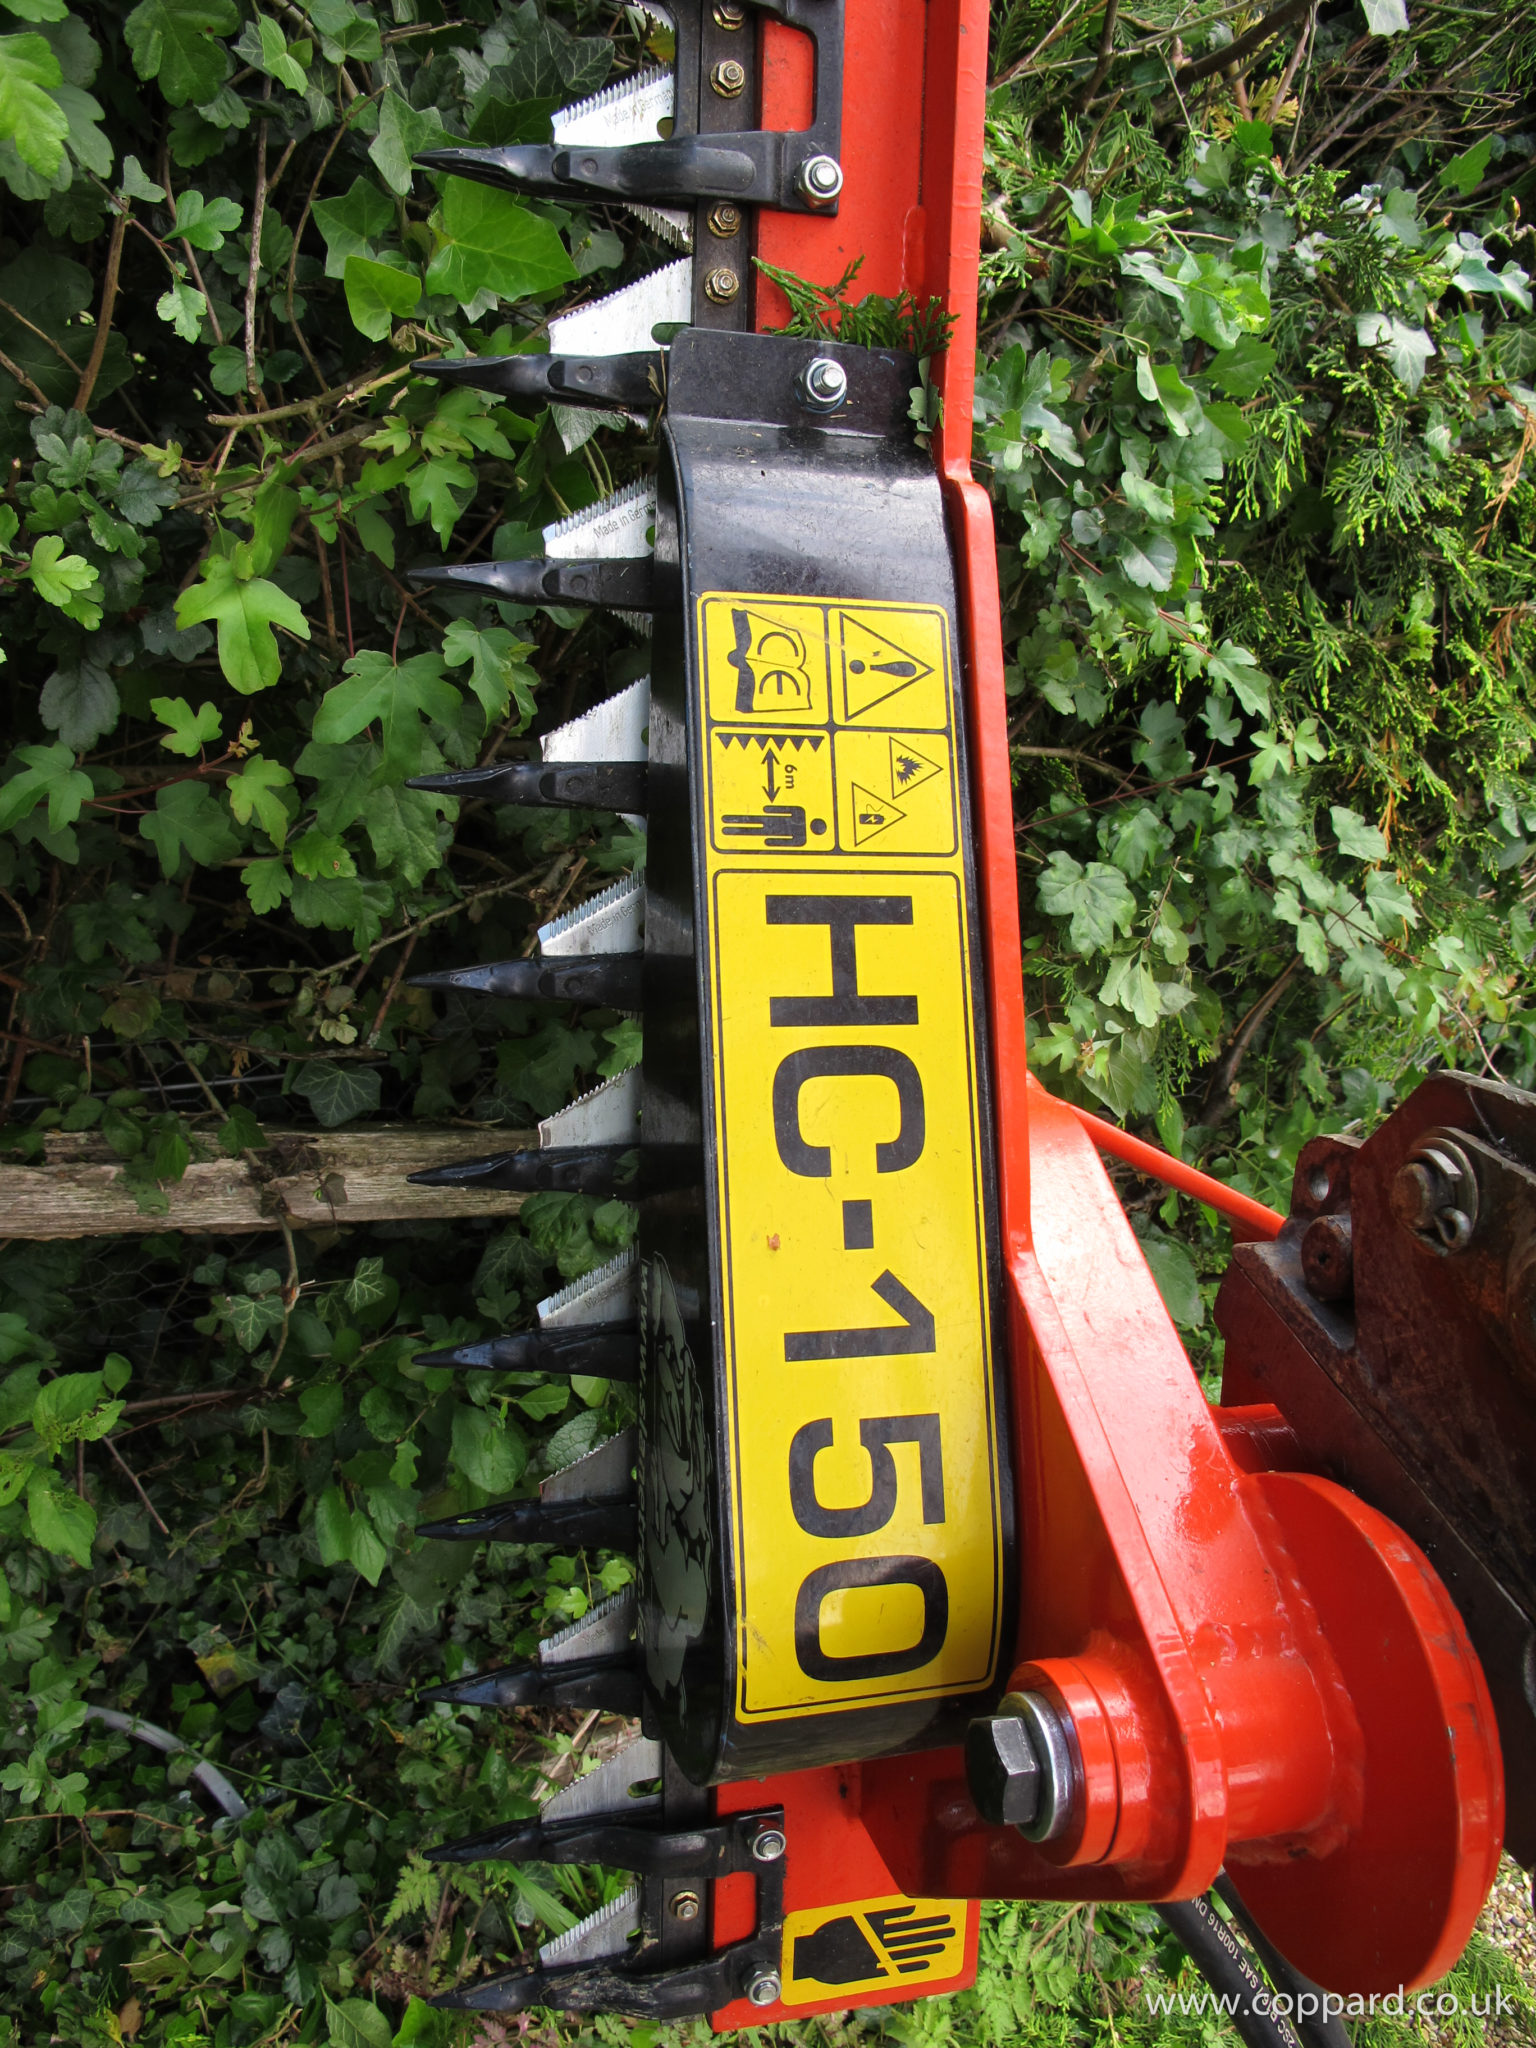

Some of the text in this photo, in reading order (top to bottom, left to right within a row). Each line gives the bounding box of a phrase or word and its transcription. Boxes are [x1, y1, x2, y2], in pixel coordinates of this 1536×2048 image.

[638, 87, 674, 112] German
[593, 501, 657, 539] Made in Germa
[784, 764, 798, 790] 6m
[586, 899, 645, 936] Made in Germ
[764, 893, 949, 1683] HC-150
[638, 1264, 648, 1645] www.slanetrac.ie
[1207, 1913, 1239, 1960] 100R16
[1238, 1957, 1259, 1988] SAE
